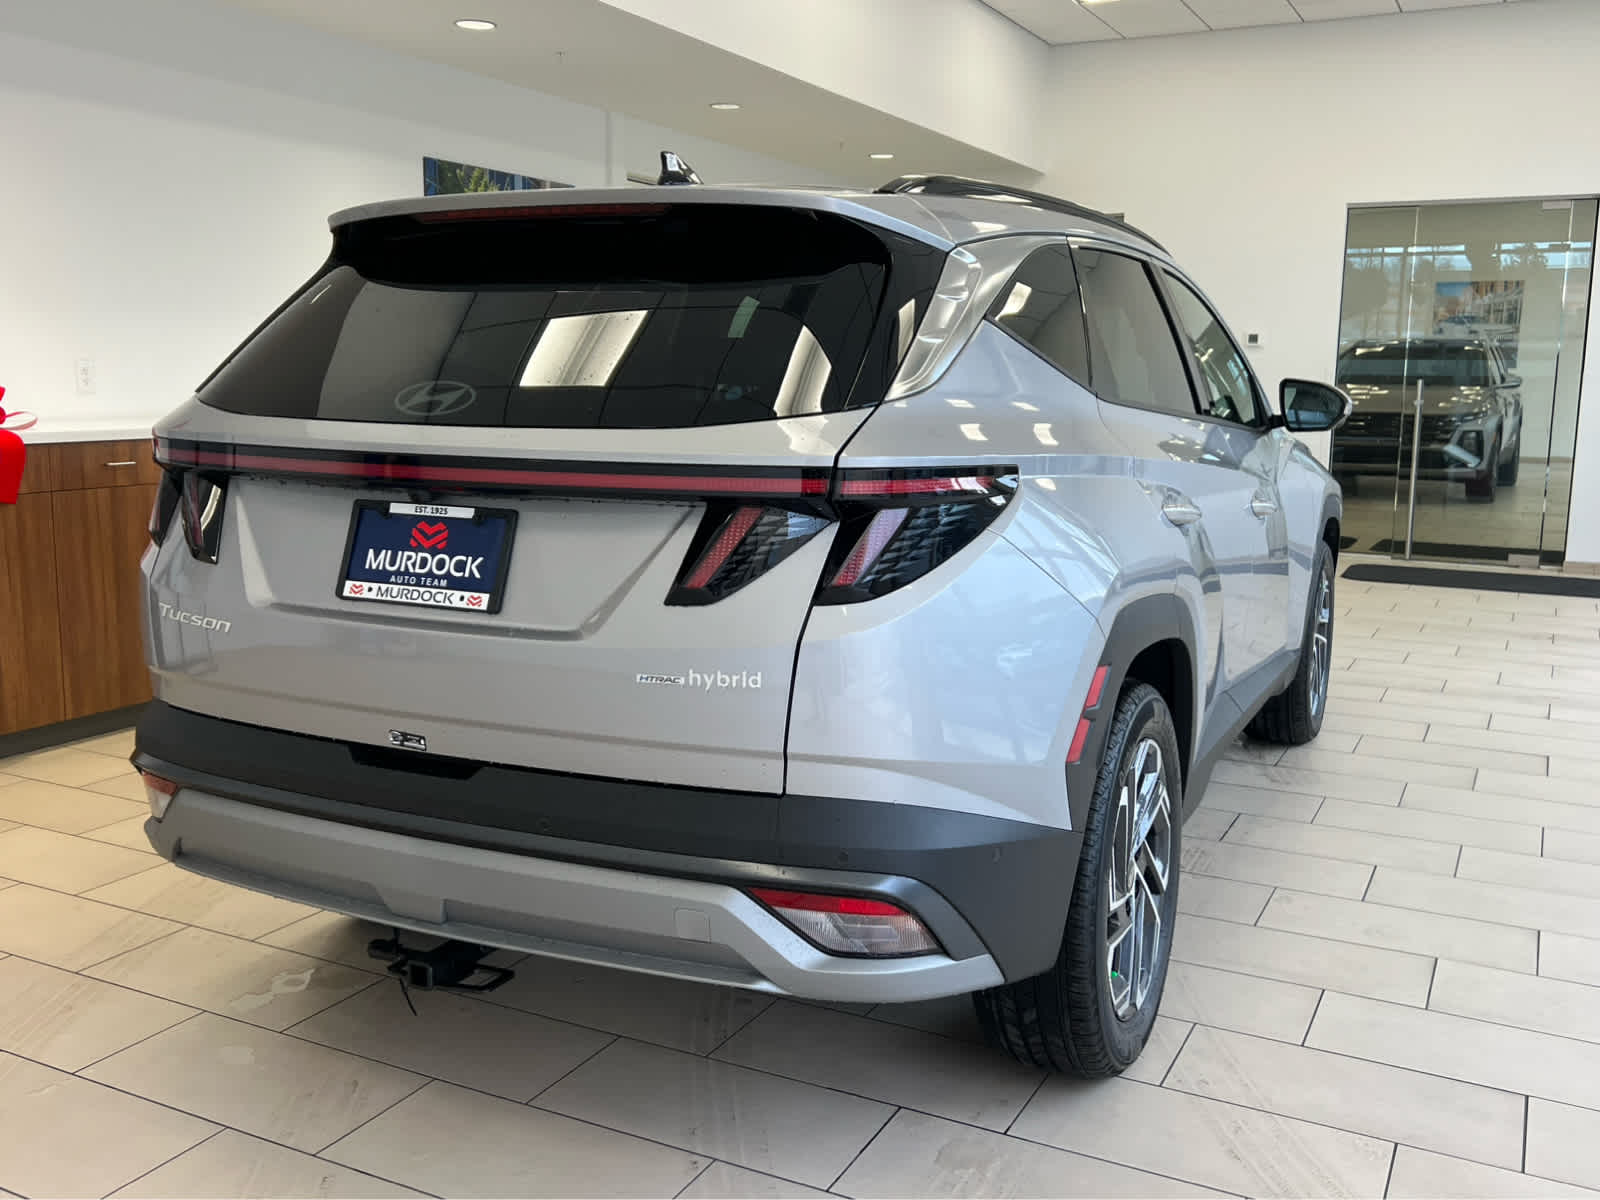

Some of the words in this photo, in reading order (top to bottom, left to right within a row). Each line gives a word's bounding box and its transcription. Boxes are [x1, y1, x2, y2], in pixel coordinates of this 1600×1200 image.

[414, 505, 430, 514] EST.
[430, 506, 448, 516] 1925
[365, 548, 485, 579] MURDOCK
[389, 574, 417, 585] AUTO
[421, 577, 448, 587] TEAM
[375, 584, 455, 605] MURDOCK
[159, 602, 232, 633] Tucson
[638, 674, 682, 684] HTRAC
[688, 668, 762, 691] hybrid
